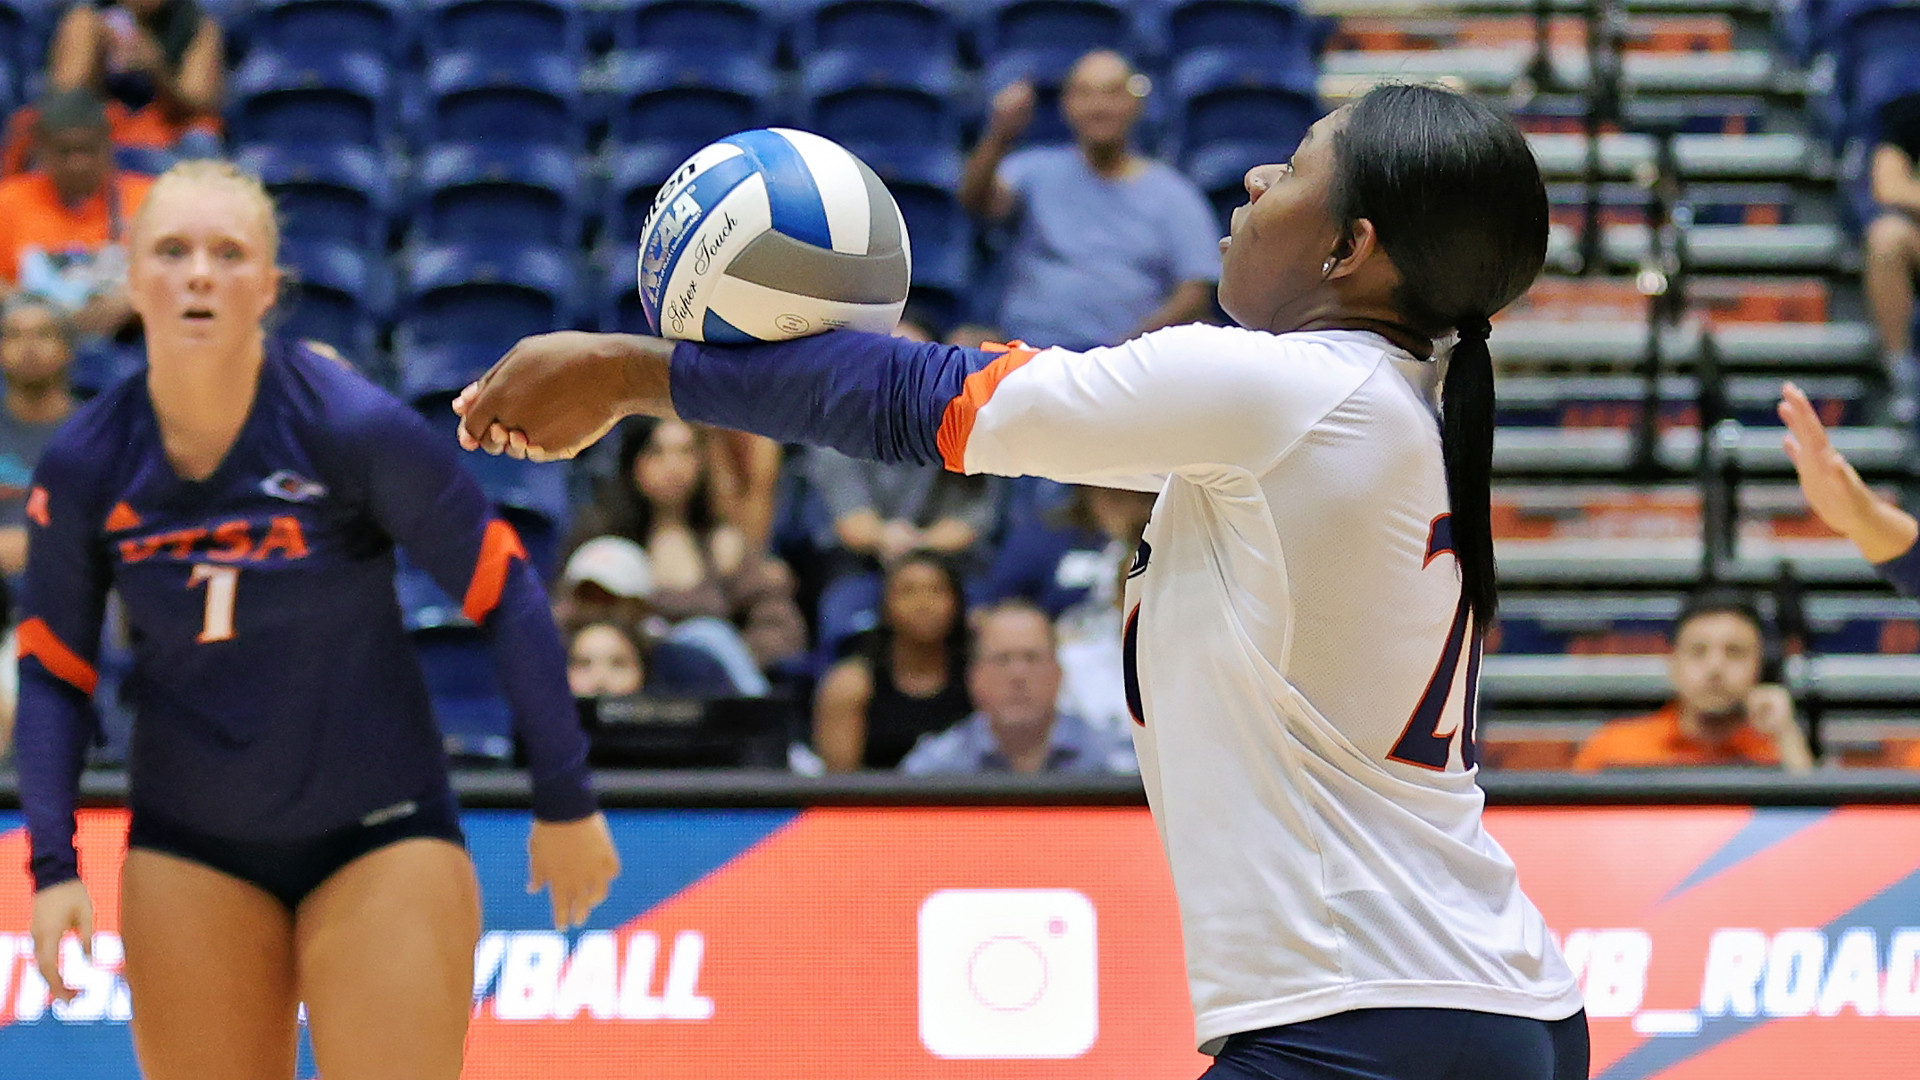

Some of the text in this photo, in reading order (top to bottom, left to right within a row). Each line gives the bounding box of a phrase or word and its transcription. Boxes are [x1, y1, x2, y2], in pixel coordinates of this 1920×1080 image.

[667, 280, 697, 334] Super
[694, 211, 738, 276] Touch
[118, 516, 310, 563] UTSA
[1385, 513, 1480, 772] 2
